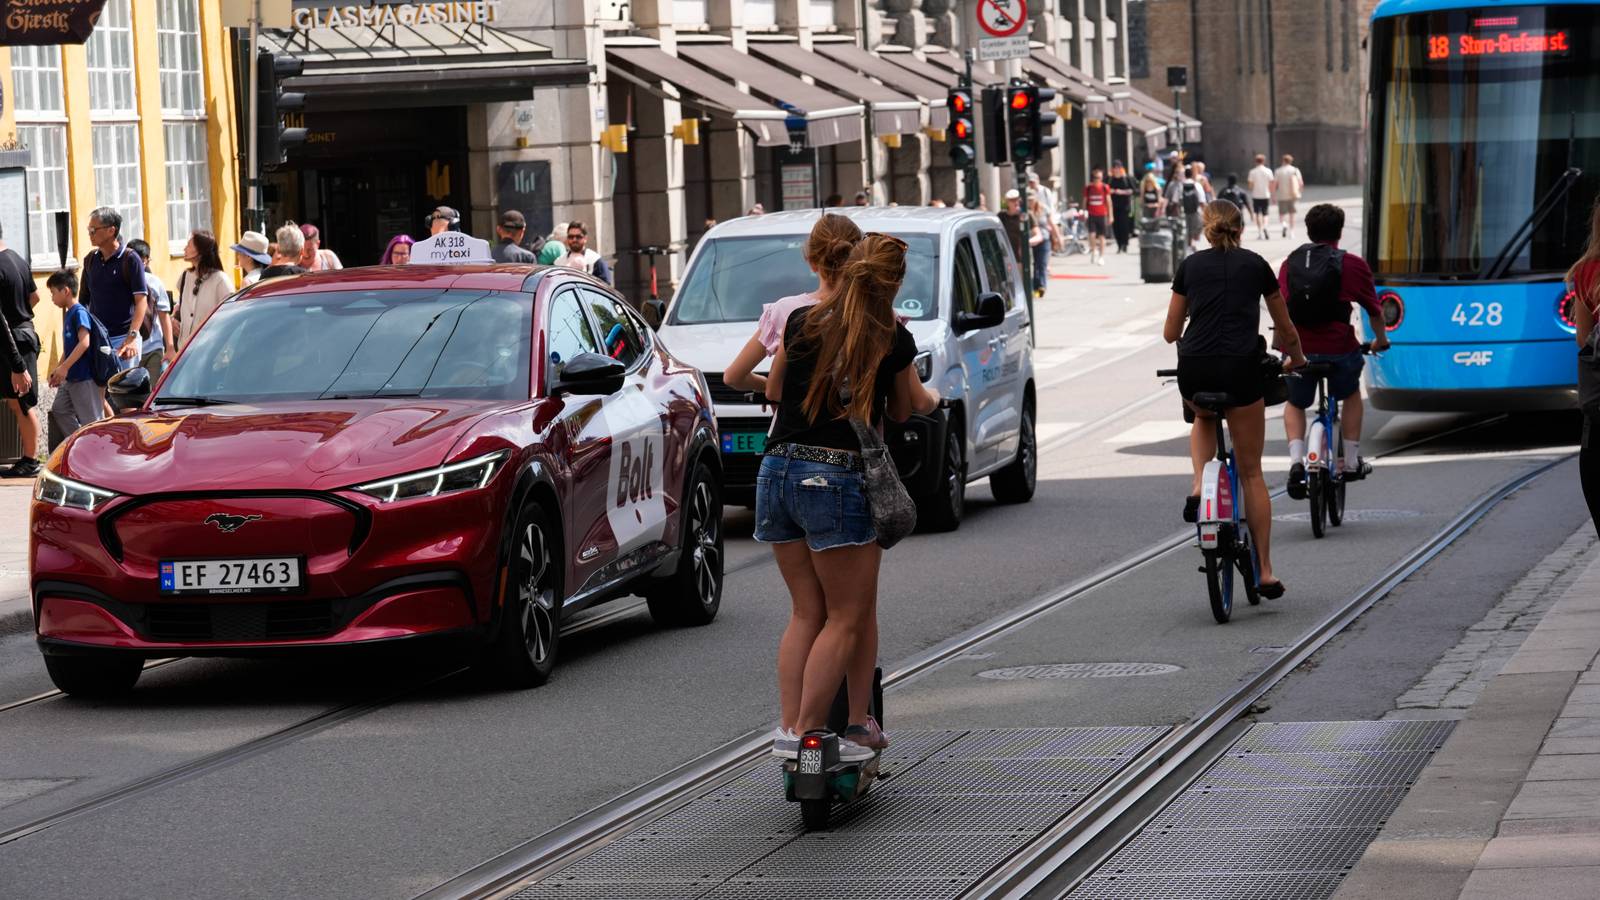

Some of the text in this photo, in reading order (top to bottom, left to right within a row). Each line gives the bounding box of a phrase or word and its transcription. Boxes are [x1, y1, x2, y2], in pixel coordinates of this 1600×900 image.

[293, 0, 500, 30] GLASMAGASINET
[1429, 35, 1450, 59] 18
[435, 236, 465, 248] AK 318
[430, 247, 471, 261] mytaxi
[1451, 302, 1503, 326] 428
[1453, 350, 1493, 366] CAF
[737, 435, 755, 450] EE
[616, 436, 654, 509] Bolt
[182, 561, 291, 587] EF 27463
[164, 579, 171, 587] N
[801, 750, 820, 762] 538
